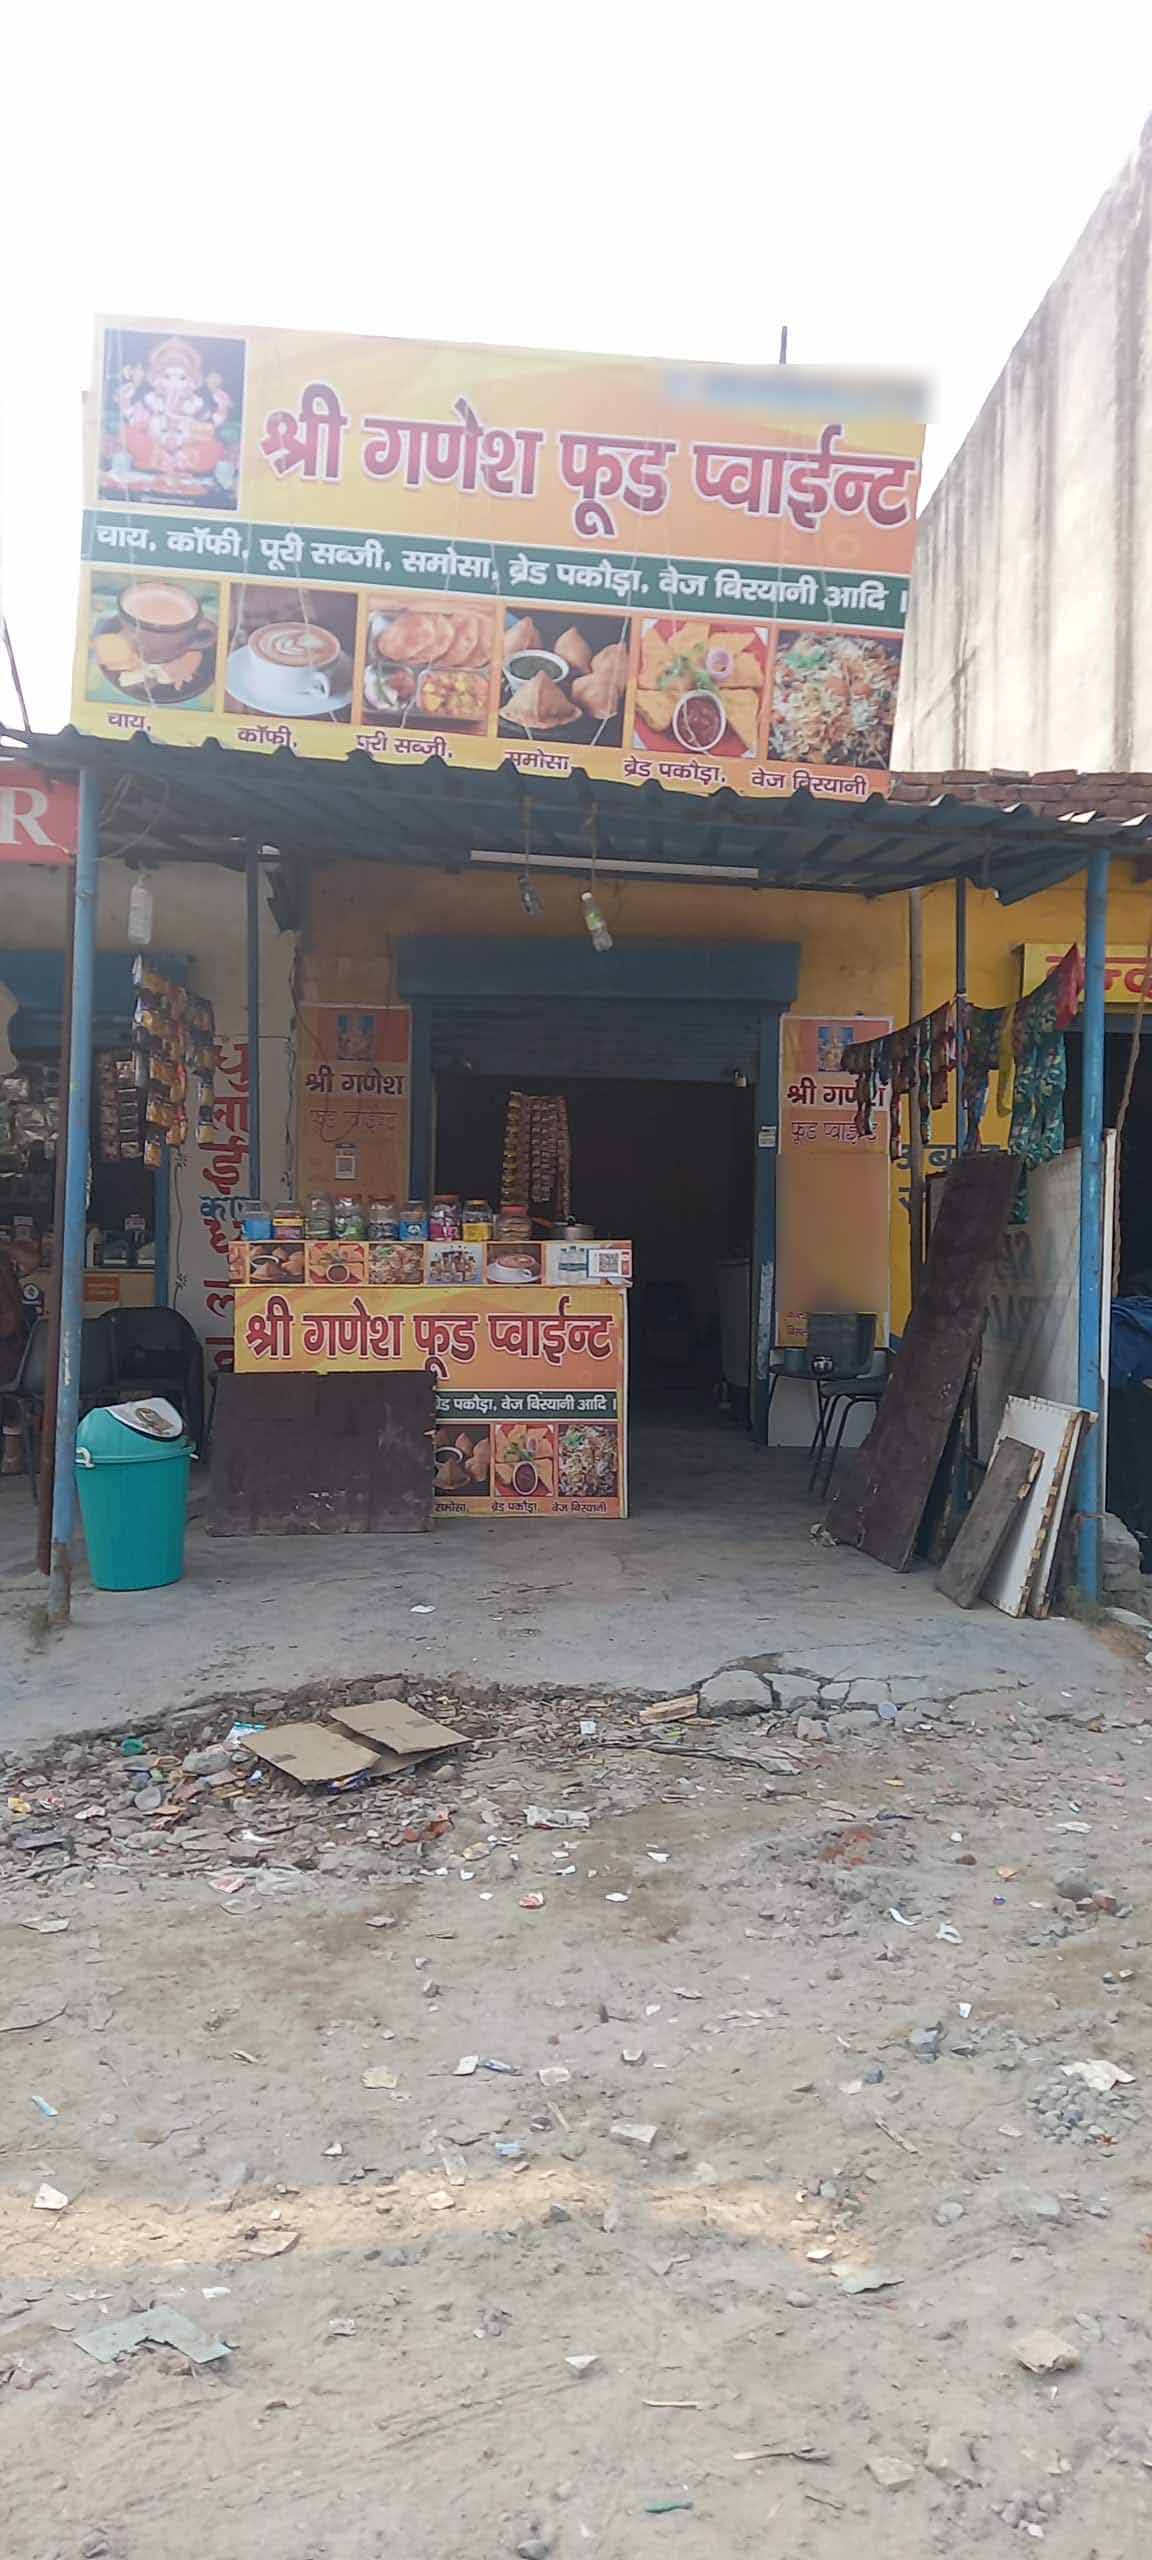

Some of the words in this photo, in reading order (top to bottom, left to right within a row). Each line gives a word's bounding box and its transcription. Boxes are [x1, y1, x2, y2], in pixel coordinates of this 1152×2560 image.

[261, 382, 348, 480] श्री
[363, 396, 544, 495] गणेश
[559, 431, 676, 538] फूड
[693, 424, 917, 530] प्वाईन्ट
[96, 525, 157, 552] चाय,
[260, 531, 304, 571] पूरी
[508, 552, 550, 586] ब्रेड
[658, 565, 709, 596] वेज
[714, 568, 818, 605] बिरयानी
[823, 579, 889, 611] आदि
[752, 767, 785, 789] वेज
[305, 1064, 335, 1093] श्री
[340, 1066, 406, 1096] गणेश
[787, 1076, 816, 1105] श्री
[245, 1295, 294, 1358] श्री
[302, 1297, 405, 1358] गणेश
[412, 1314, 479, 1379] फूड
[488, 1295, 614, 1365] प्वाईन्ट
[501, 1394, 524, 1410] वेज
[577, 1394, 608, 1410] आदि
